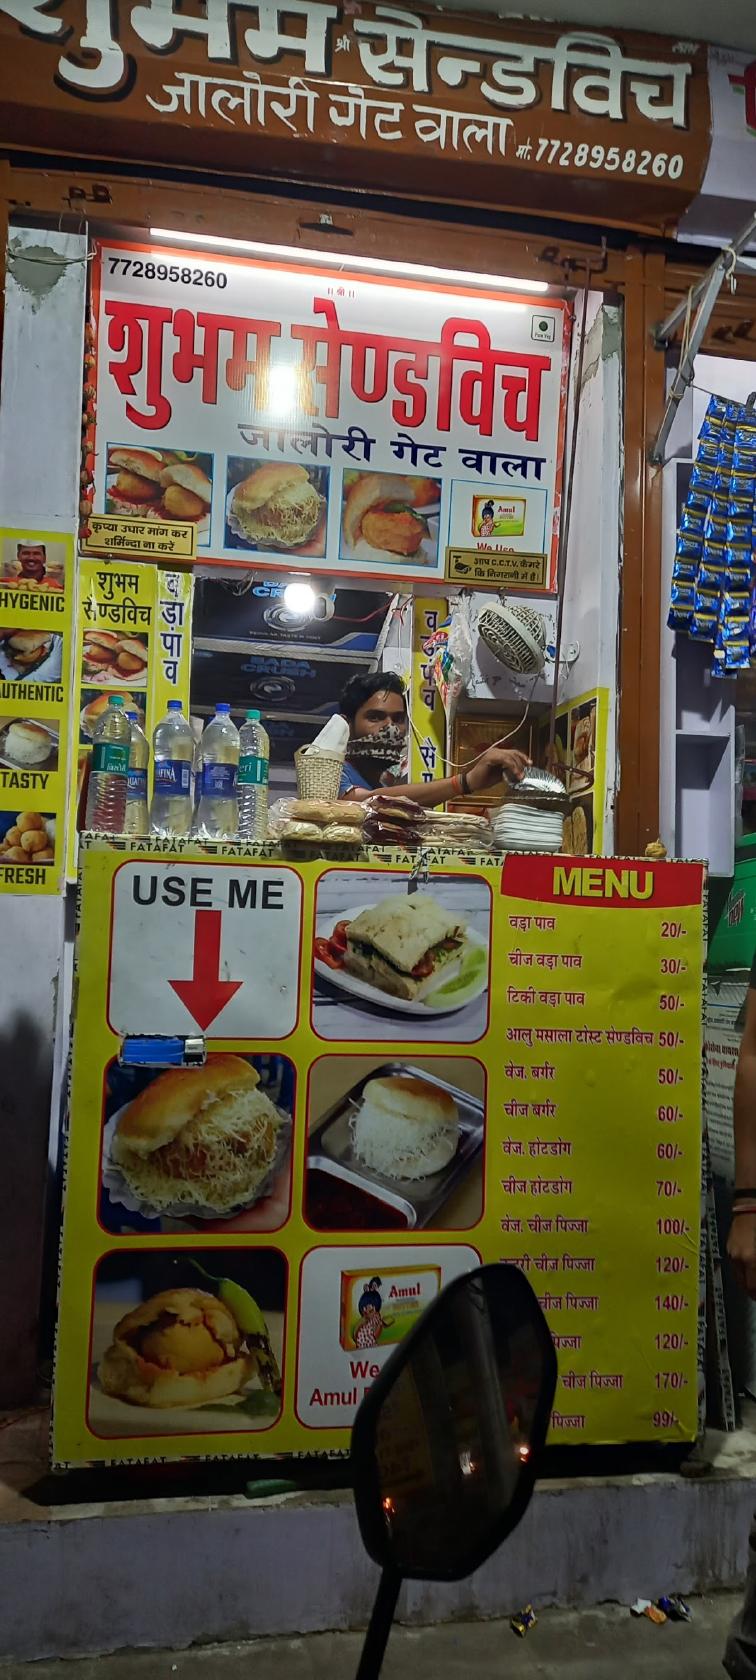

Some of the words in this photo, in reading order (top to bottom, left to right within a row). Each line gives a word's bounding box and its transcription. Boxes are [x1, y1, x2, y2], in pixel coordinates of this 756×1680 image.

[146, 71, 320, 133] जालोरी
[329, 85, 405, 141] गेट
[414, 104, 513, 157] वाला
[535, 138, 684, 179] 7728958260
[108, 257, 228, 289] 7728958260
[105, 299, 281, 430] शुभम
[291, 296, 551, 441] सेण्डविच
[237, 424, 376, 463] जालोरी
[390, 432, 446, 468] गेट
[458, 448, 546, 480] वाला
[497, 505, 516, 514] Amul
[171, 529, 188, 539] कर
[143, 540, 155, 550] ना
[96, 571, 139, 600] शुभम
[0, 591, 65, 613] HYGENIC
[0, 771, 49, 789] TASTY
[130, 841, 185, 853] FATAFAT
[221, 845, 274, 858] FATAFAT
[395, 855, 446, 866] FATFAT
[132, 874, 213, 908] USE
[228, 878, 284, 910] ME
[553, 867, 654, 899] MENU
[509, 915, 531, 932] वड़ा
[533, 917, 556, 931] पाव
[660, 922, 687, 938] 20/-
[508, 949, 533, 966] चीज
[536, 954, 558, 970] वड़ा
[561, 956, 583, 969] पाव
[660, 959, 687, 974] 30/-
[507, 986, 535, 1005] टिकी
[539, 992, 561, 1008] वड़ा
[564, 993, 585, 1006] पाव
[659, 995, 685, 1011] 50/-
[535, 1029, 573, 1043] मसाला
[659, 1032, 685, 1048] 50/-
[504, 1061, 527, 1080] वेज.
[531, 1061, 556, 1080] बर्गर
[658, 1068, 684, 1085] 50/-
[504, 1099, 528, 1117] चीज
[532, 1099, 557, 1118] बर्गर
[657, 1105, 684, 1122] 60/-
[503, 1137, 525, 1156] वेज.
[657, 1143, 683, 1160] 60/-
[502, 1176, 527, 1194] चीज
[656, 1180, 682, 1197] 70/-
[501, 1214, 524, 1233] वेज.
[527, 1214, 552, 1233] चीज
[556, 1214, 589, 1233] पिज्जा
[656, 1218, 690, 1235] 100/-
[534, 1253, 558, 1272] चीज
[562, 1253, 595, 1272] पिज्जा
[656, 1257, 689, 1273] 120/-
[388, 1282, 421, 1299] Amul
[566, 1292, 599, 1311] पिज्जा
[655, 1295, 689, 1312] 140/-
[655, 1333, 689, 1350] 120/-
[349, 1361, 380, 1379] We
[561, 1370, 586, 1389] चीज
[590, 1370, 624, 1389] पिज्जा
[655, 1372, 688, 1389] 170/-
[309, 1387, 357, 1407] Amul
[551, 1410, 585, 1429] पिज्जा
